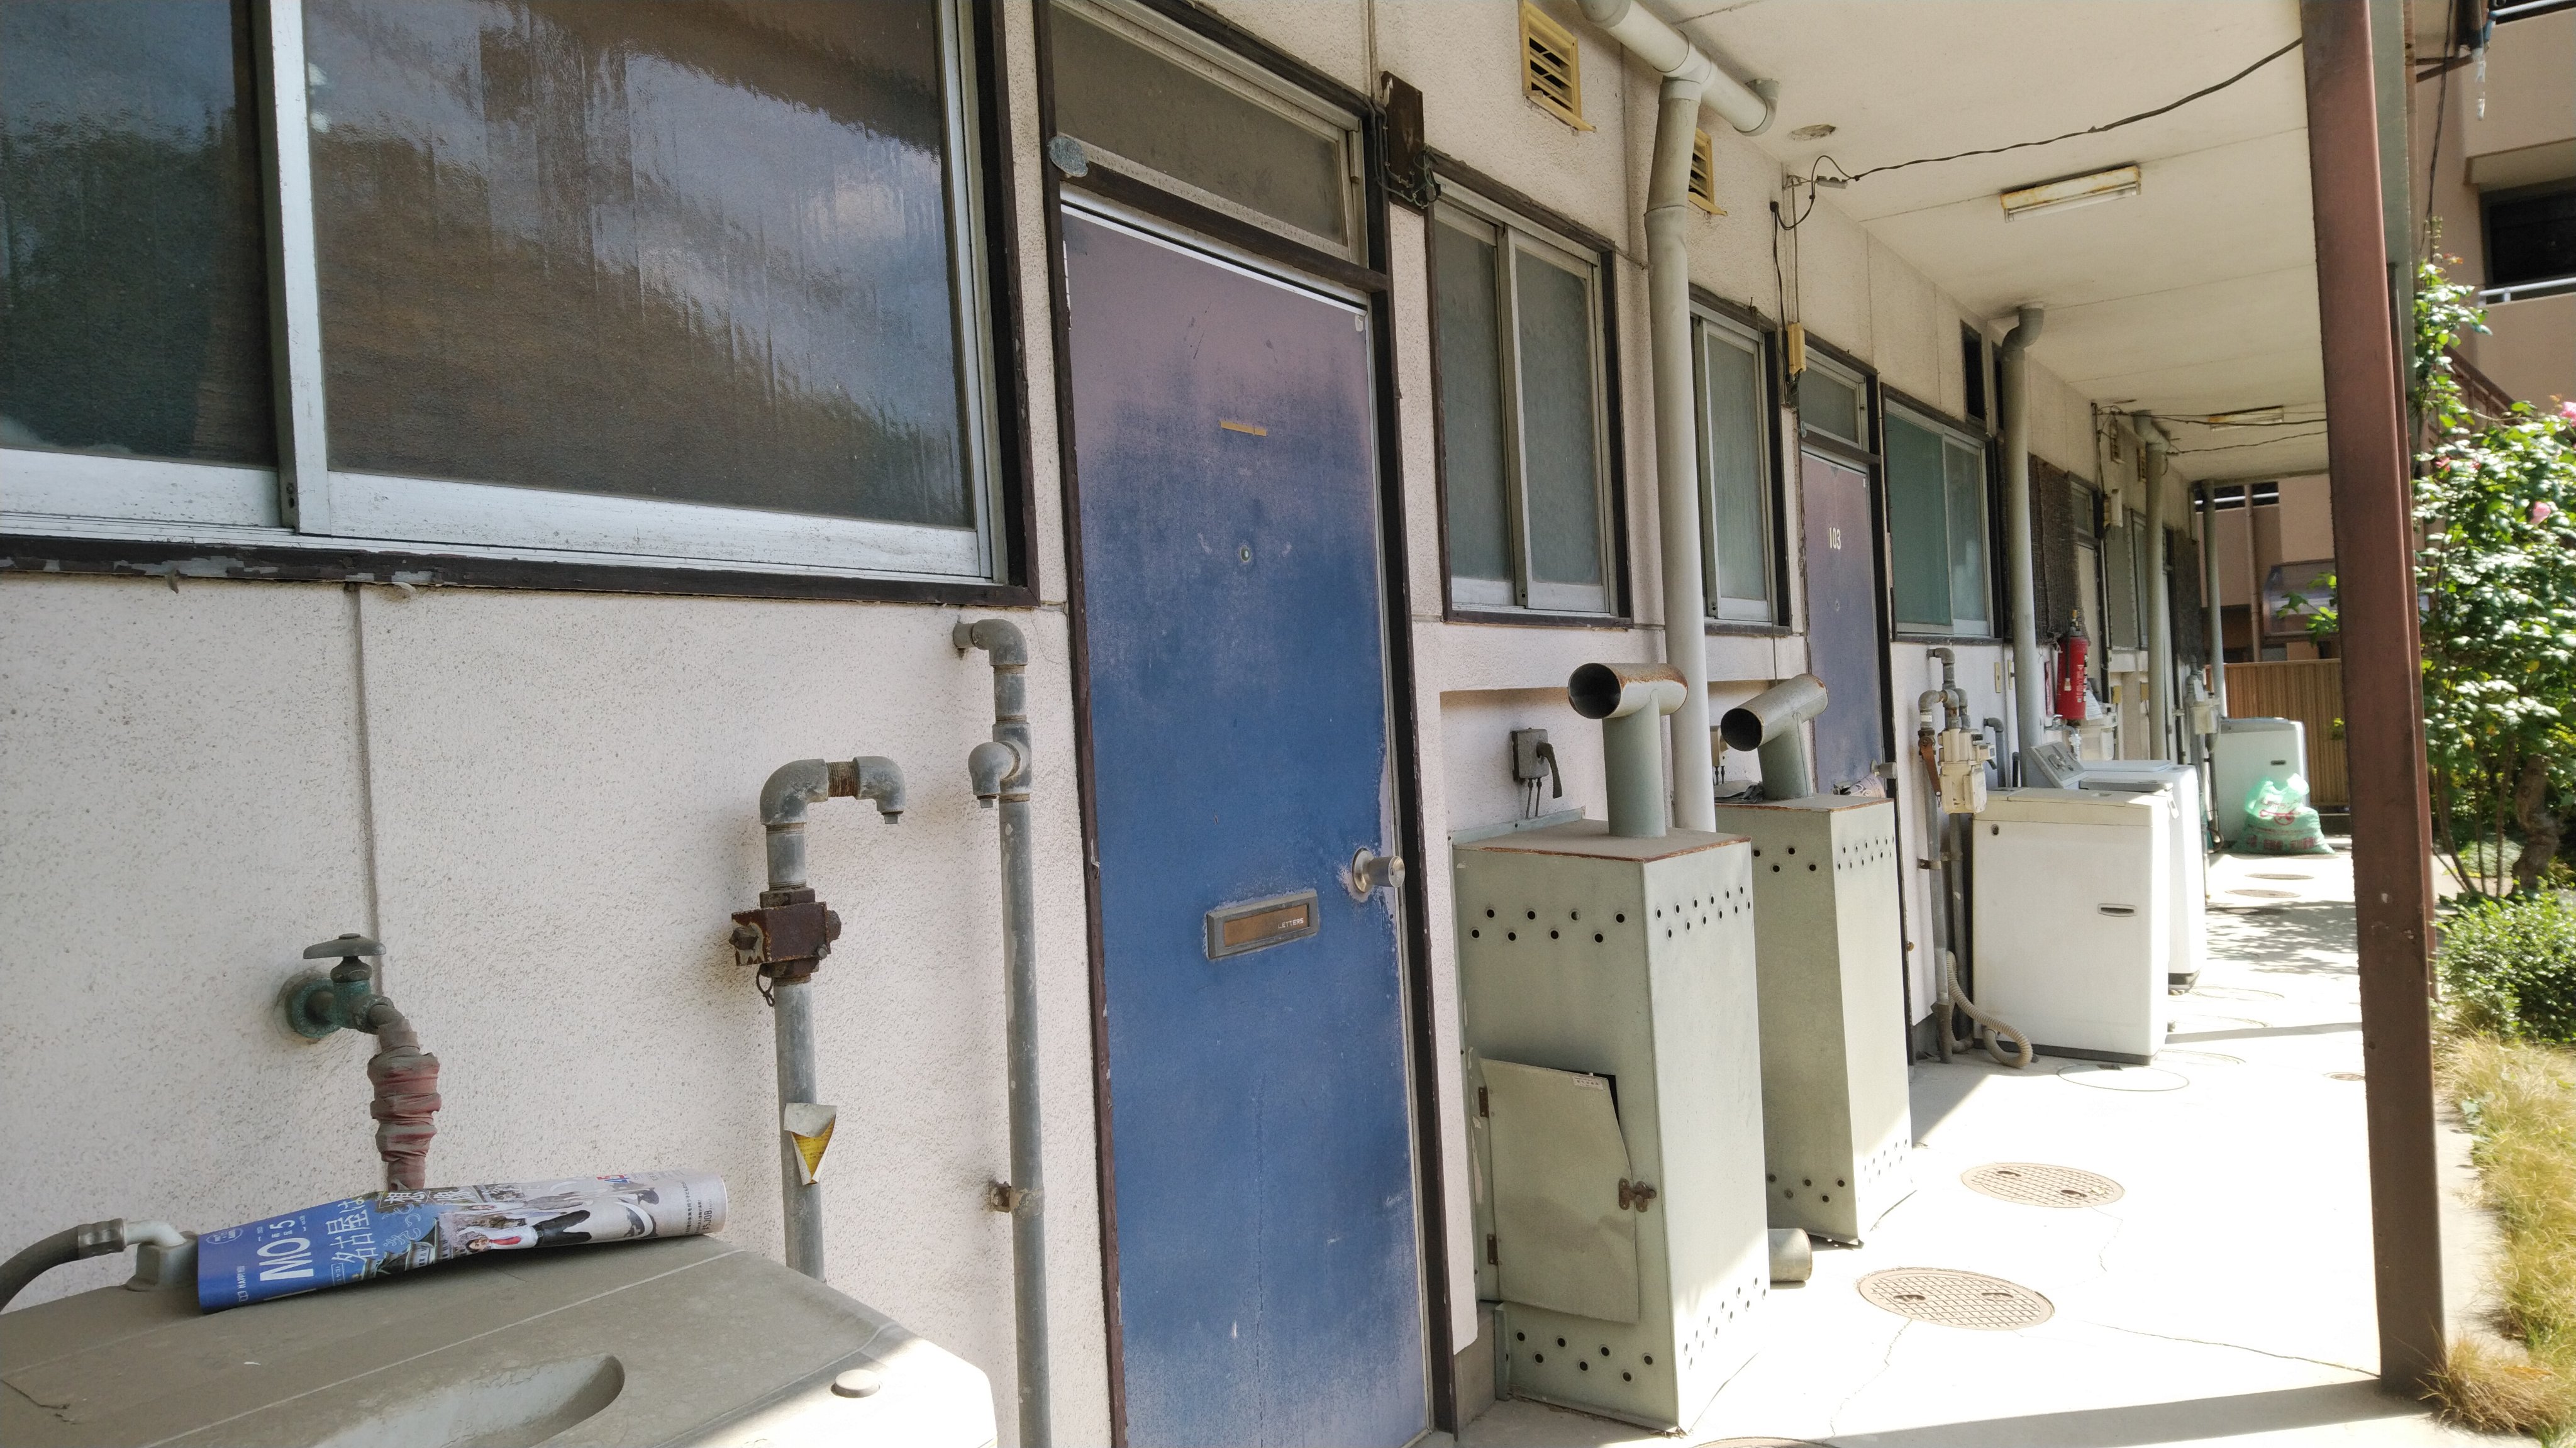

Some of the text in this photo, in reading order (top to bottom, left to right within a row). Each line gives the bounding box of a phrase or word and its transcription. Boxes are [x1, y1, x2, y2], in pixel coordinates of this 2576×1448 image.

[1829, 527, 1841, 550] 103
[1277, 917, 1304, 929] LETTERS
[269, 1220, 296, 1230] 5
[325, 1196, 379, 1263] 名古屋は
[382, 1204, 421, 1247] きっと
